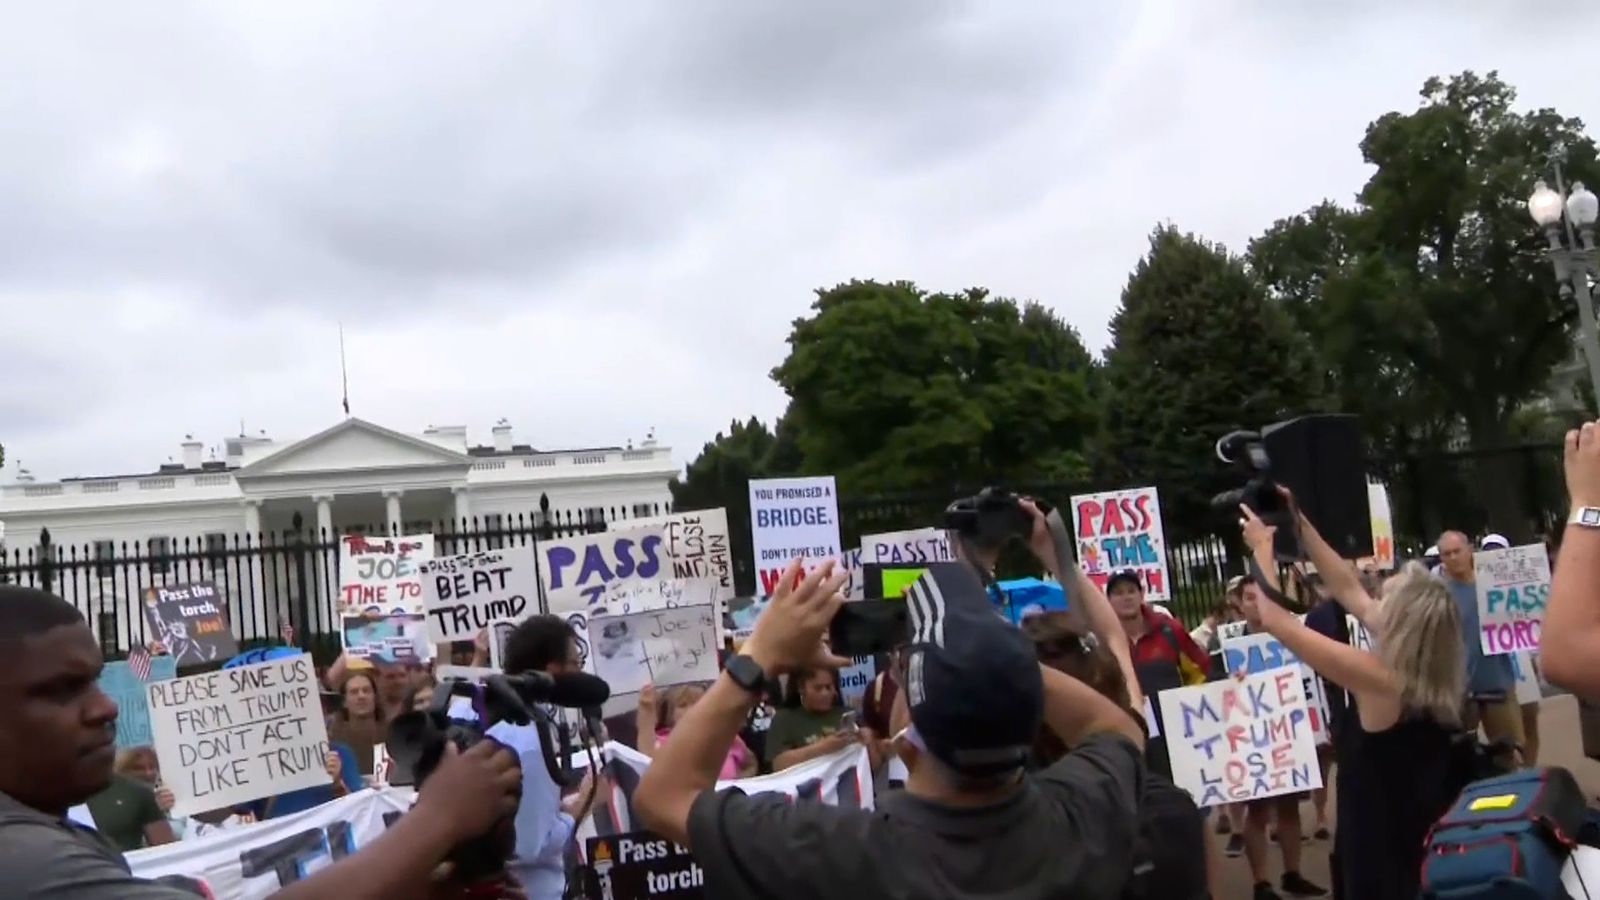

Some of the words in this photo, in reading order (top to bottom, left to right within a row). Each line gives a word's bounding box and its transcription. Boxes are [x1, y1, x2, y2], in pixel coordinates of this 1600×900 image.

[755, 489, 773, 500] YOU
[775, 486, 823, 500] PROMISED
[824, 485, 832, 497] A
[757, 506, 833, 528] BRIDGE.
[1078, 495, 1152, 538] PASS
[546, 535, 662, 590] PASS
[762, 549, 788, 560] DON'T
[790, 546, 812, 560] GIVE
[813, 547, 825, 557] US
[828, 546, 835, 556] A
[875, 540, 927, 564] PASS
[1101, 533, 1158, 567] THE
[159, 588, 190, 603] Pass
[191, 584, 214, 598] the
[342, 584, 387, 605] TIME
[396, 581, 421, 600] TO
[435, 566, 513, 601] BEAT
[179, 600, 220, 617] torch.
[428, 594, 527, 637] TRUMP
[1482, 619, 1542, 653] TORC
[150, 674, 219, 708] PLEASE
[230, 666, 276, 694] SAVE
[281, 660, 309, 684] US
[176, 703, 233, 735] FROM
[239, 687, 310, 719] TRUMP
[1180, 671, 1298, 738] MAKE
[178, 728, 254, 768] DON'T
[263, 717, 307, 745] ACT
[1193, 709, 1305, 760] TRUMP
[191, 758, 250, 797] LIKE
[257, 740, 330, 780] TRUMP
[1200, 743, 1296, 785] LOSE
[1201, 763, 1311, 805] AGAIN
[618, 838, 668, 864] Pass
[646, 862, 704, 894] torch
